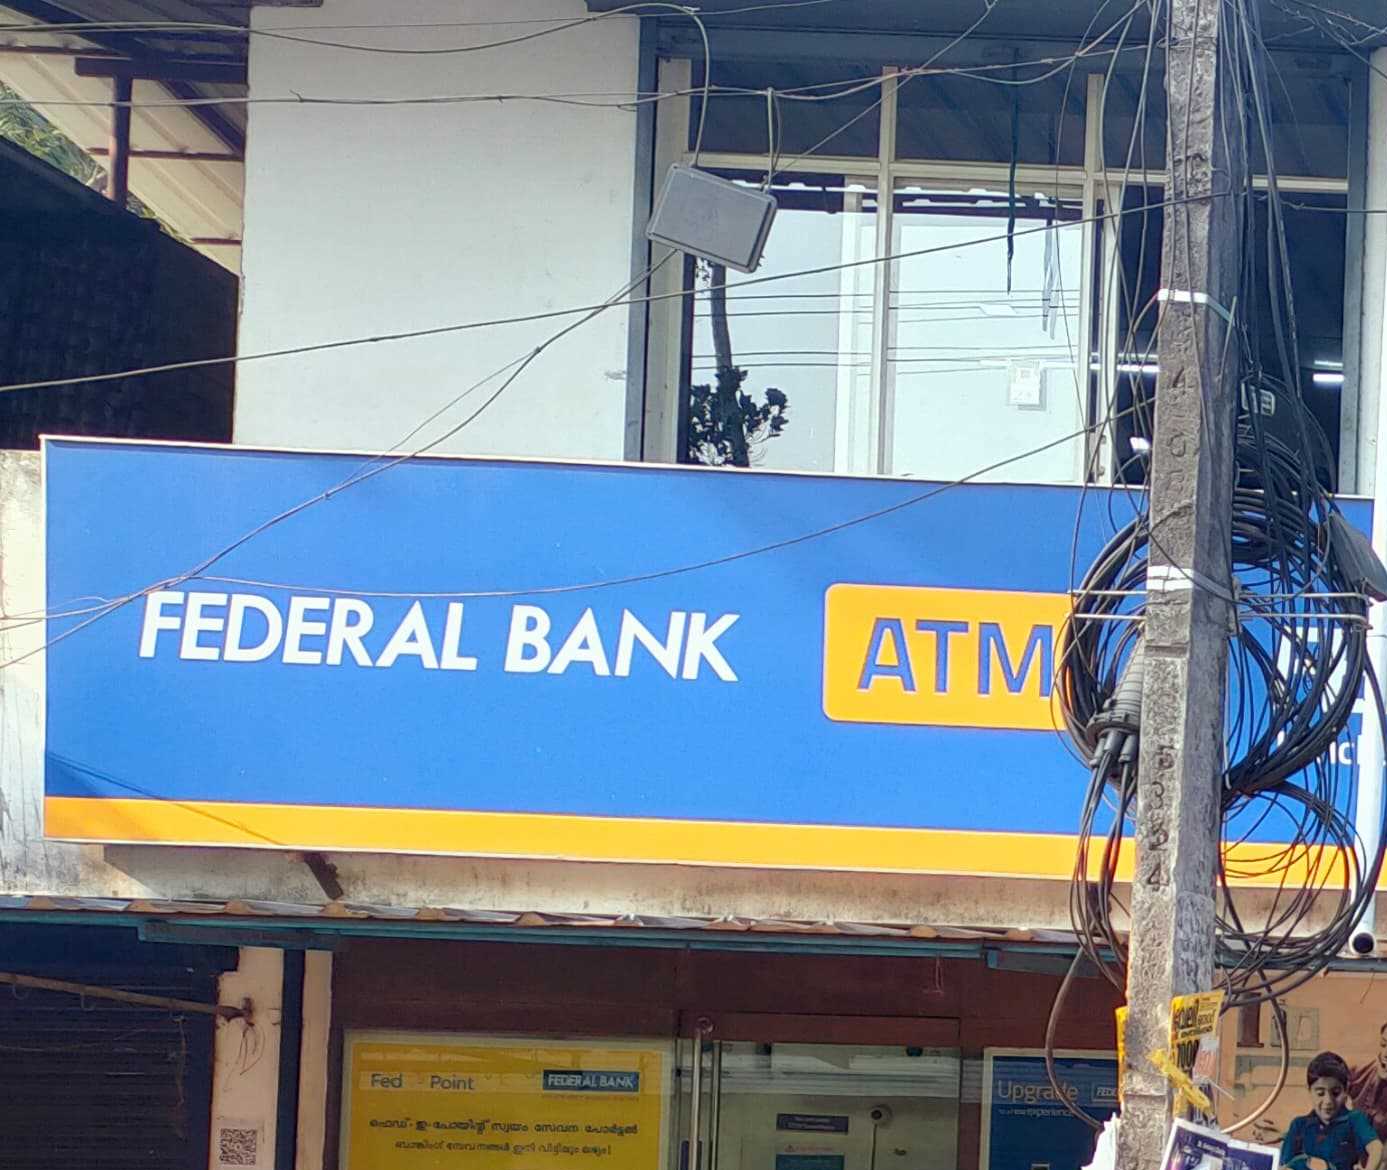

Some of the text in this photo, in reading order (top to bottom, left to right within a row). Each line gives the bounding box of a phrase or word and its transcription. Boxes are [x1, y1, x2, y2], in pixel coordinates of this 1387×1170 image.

[138, 591, 740, 683] FEDERAL BANK
[856, 616, 1054, 699] ATM
[548, 1074, 635, 1089] FEDERAL BANK
